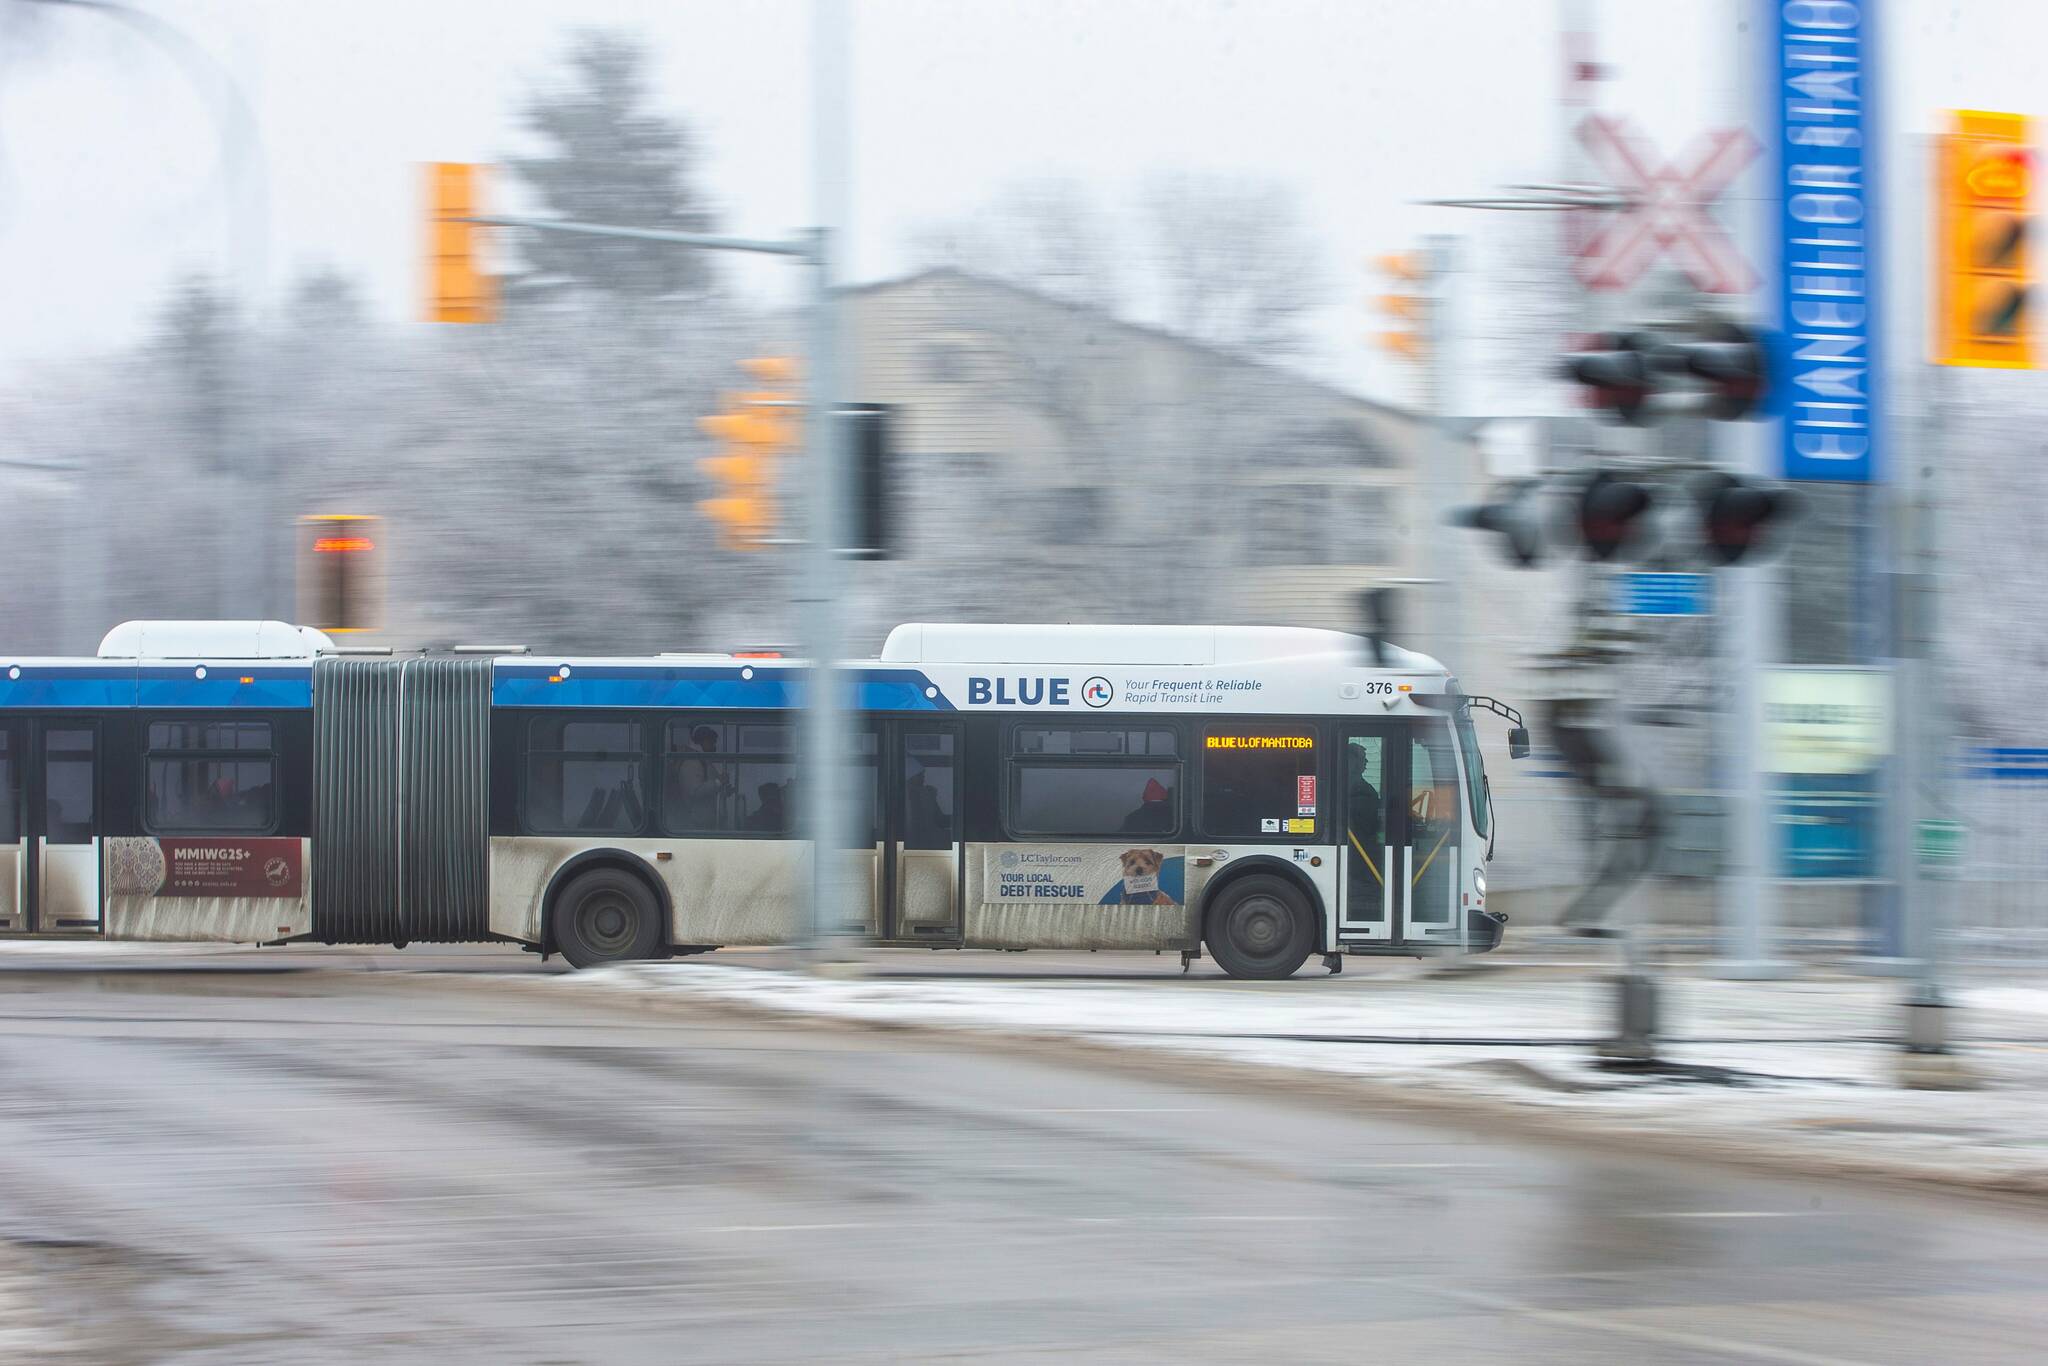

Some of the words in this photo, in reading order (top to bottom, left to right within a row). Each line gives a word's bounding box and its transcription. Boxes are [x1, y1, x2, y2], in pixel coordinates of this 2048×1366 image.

[968, 677, 1070, 705] BLUE
[1125, 680, 1149, 690] Your
[1152, 680, 1202, 692] Frequent
[1205, 680, 1213, 690] &
[1216, 680, 1262, 690] Reliable
[1366, 682, 1393, 694] 376
[1125, 692, 1158, 704] Rapid
[1161, 693, 1198, 703] Transit
[1200, 693, 1223, 703] Line
[1207, 737, 1236, 748] BLUE
[1261, 737, 1313, 748] MANITOBA
[174, 847, 251, 860] MMIWG2S+
[1001, 873, 1024, 882] YOUR
[1027, 873, 1053, 882] LOCAL
[1000, 885, 1031, 897] DEBT
[1035, 885, 1084, 897] RESCUE
